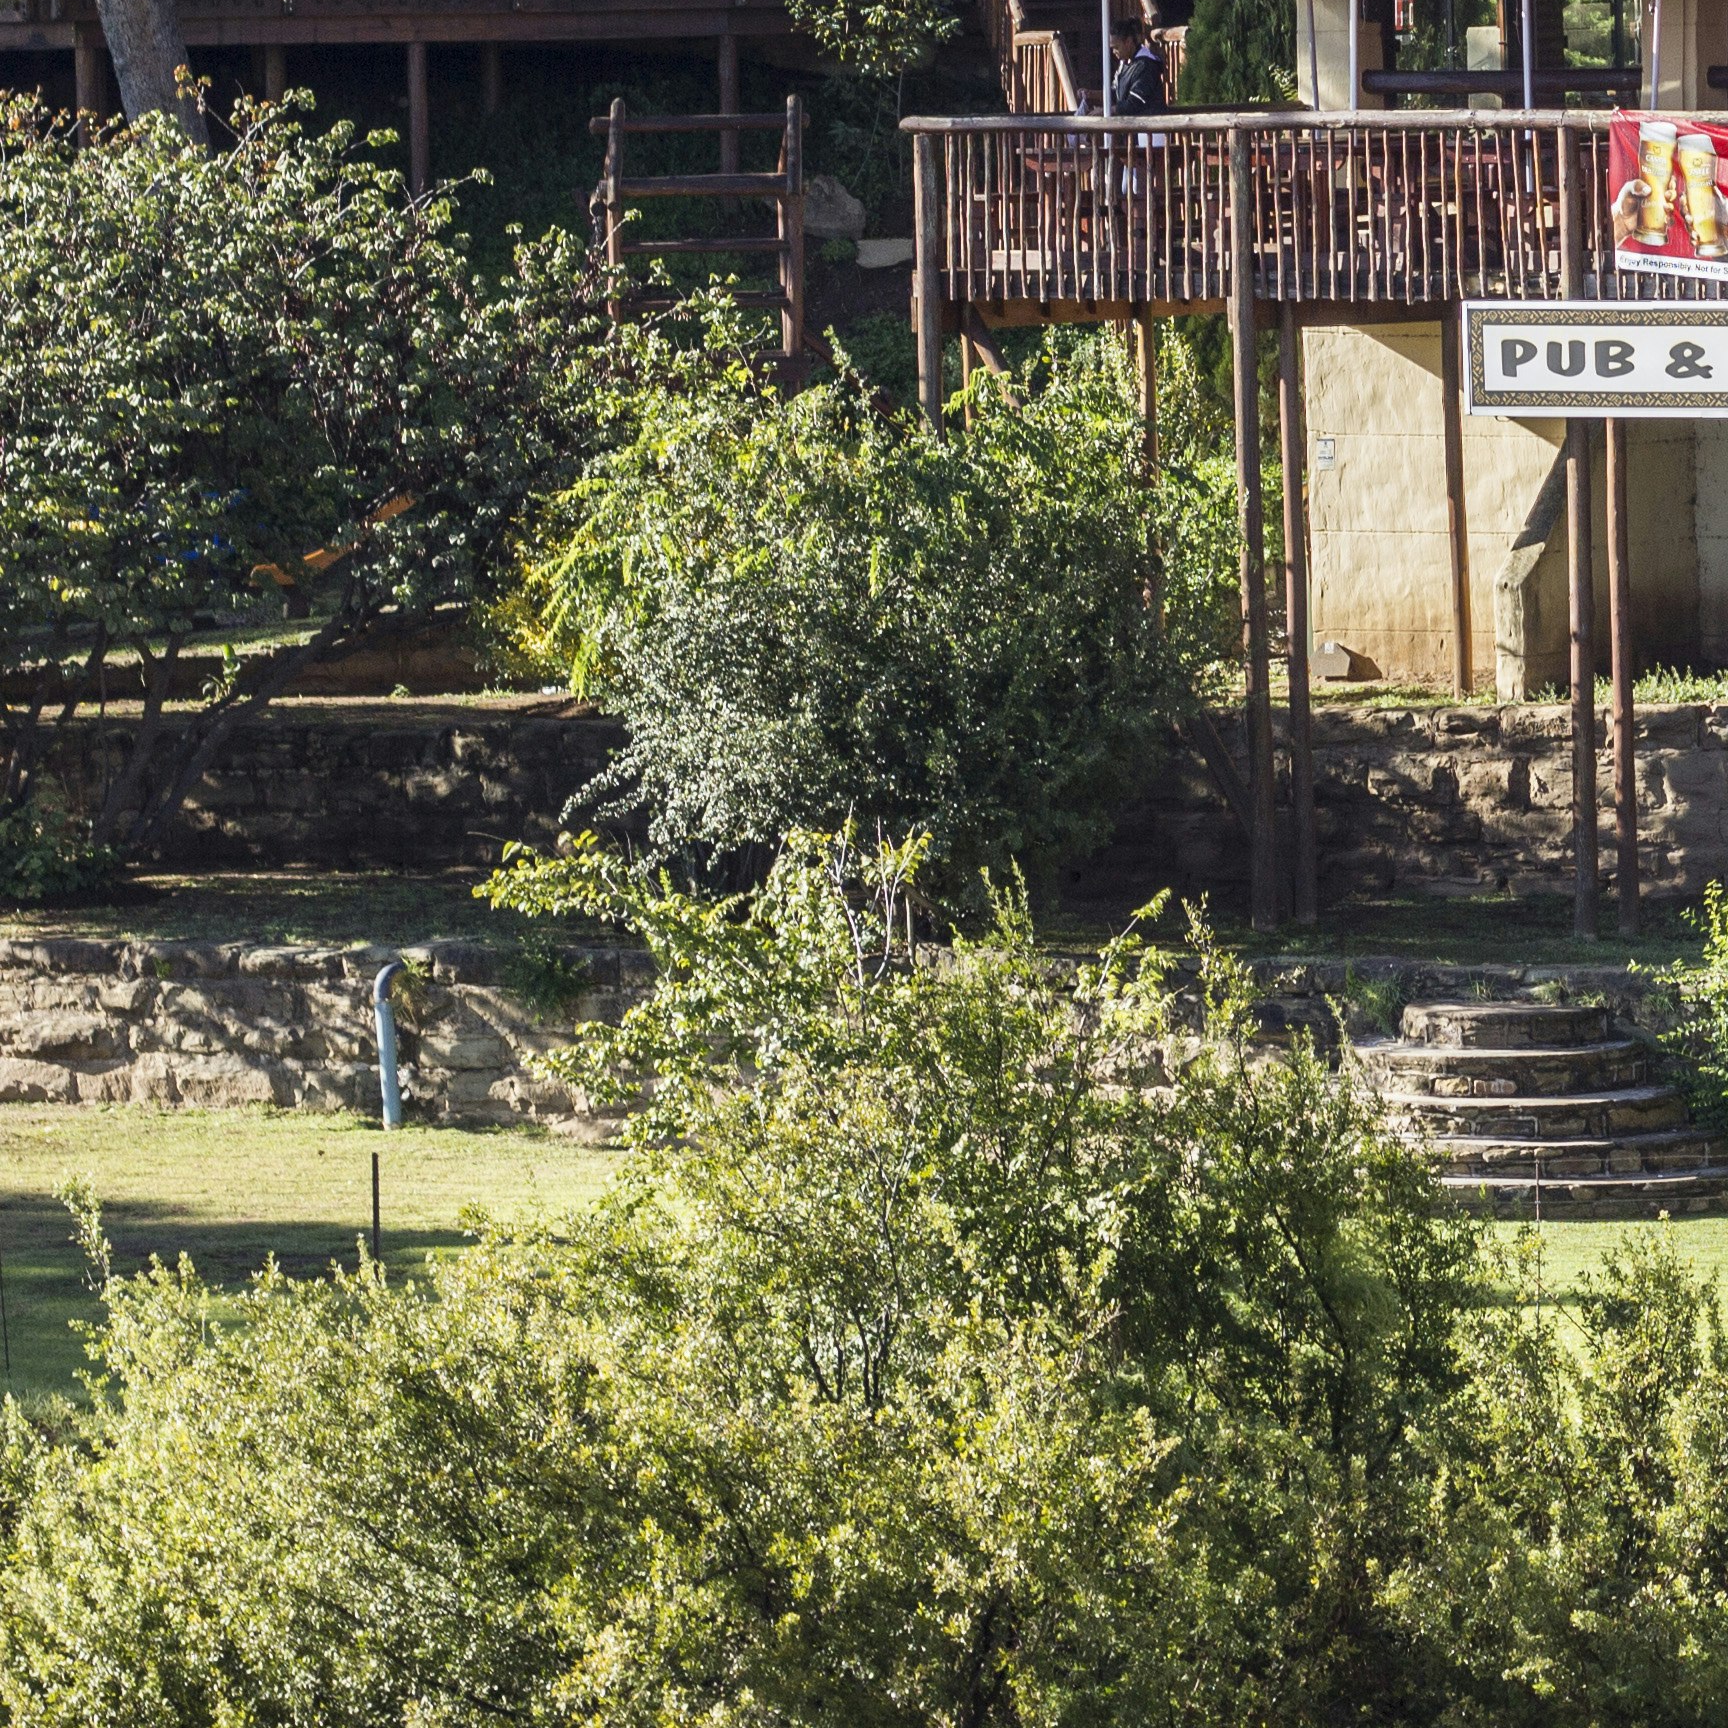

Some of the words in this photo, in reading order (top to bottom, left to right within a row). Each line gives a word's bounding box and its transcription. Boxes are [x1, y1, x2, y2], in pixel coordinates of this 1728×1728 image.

[1620, 255, 1641, 267] Enjoy
[1695, 264, 1709, 272] Not
[1710, 266, 1721, 274] for
[1500, 338, 1636, 378] PUB
[1665, 341, 1713, 379] &
